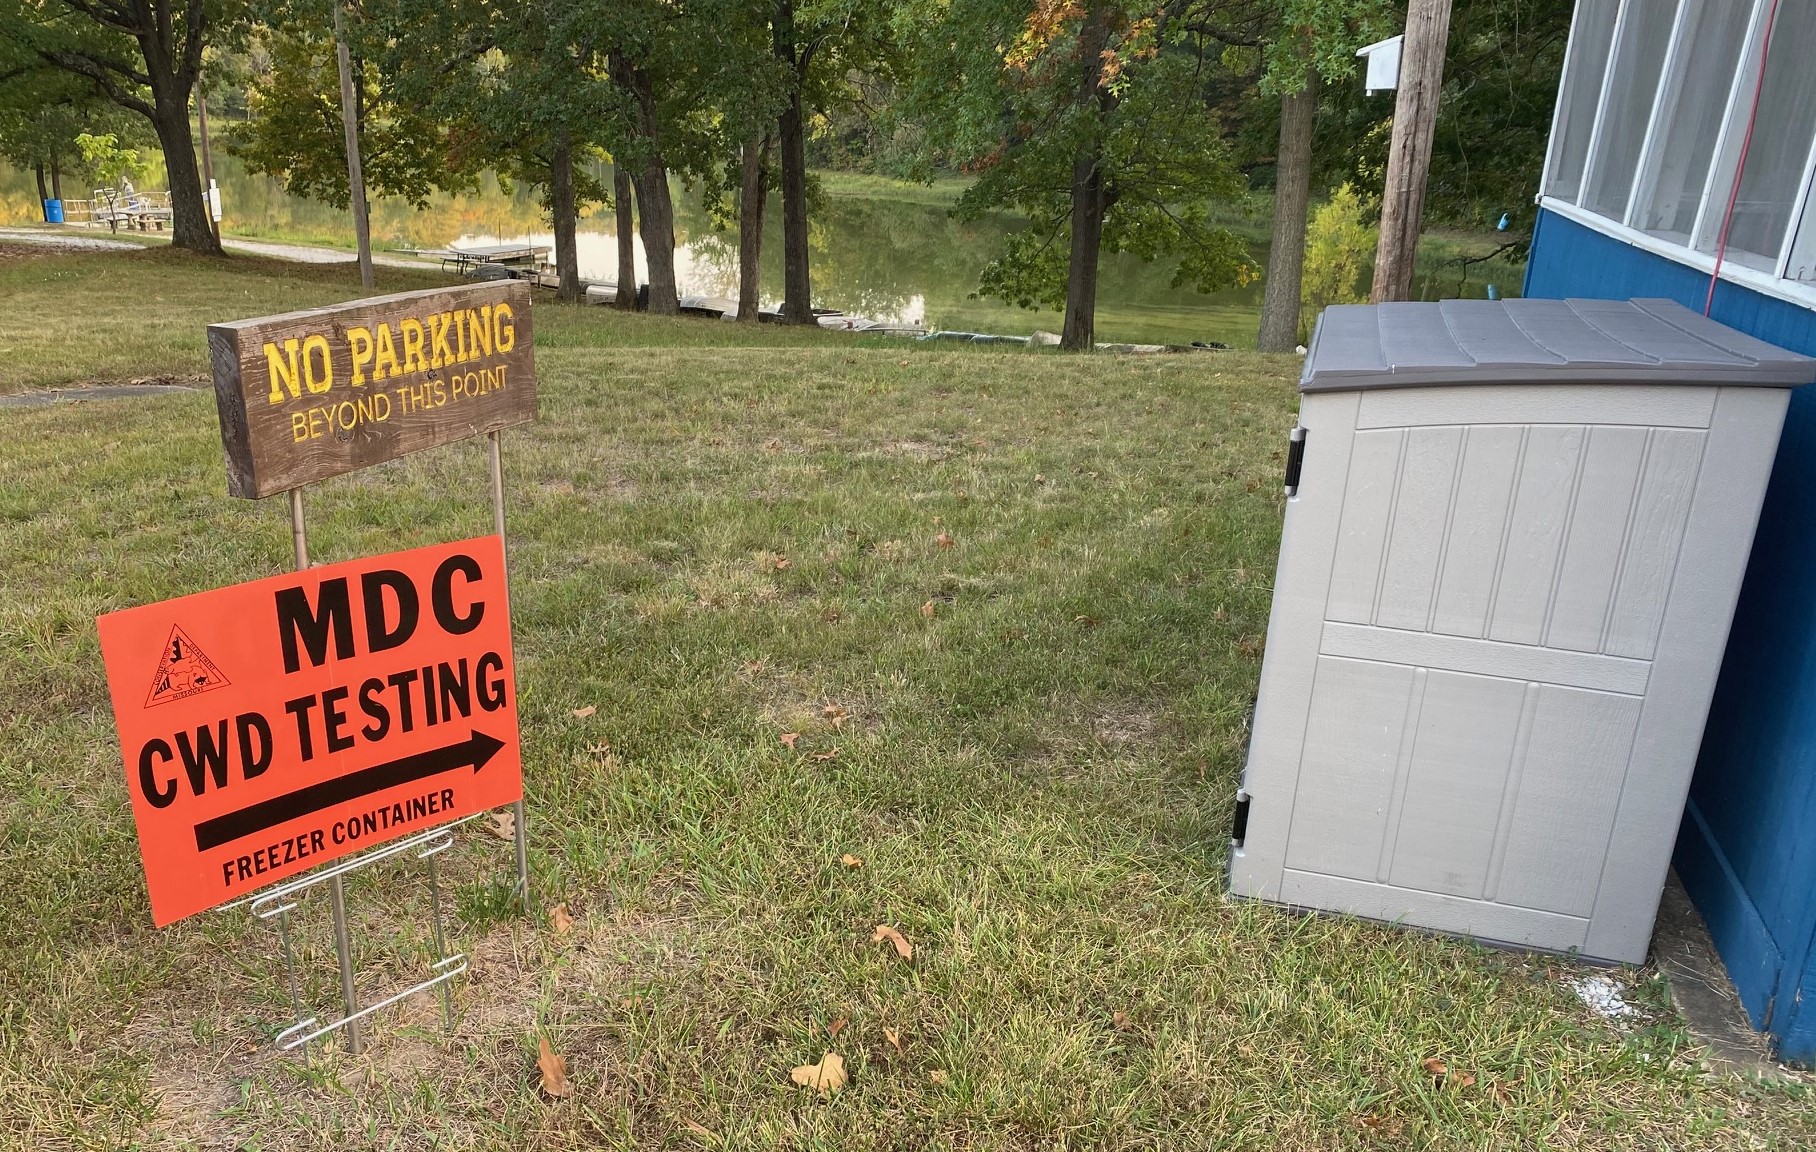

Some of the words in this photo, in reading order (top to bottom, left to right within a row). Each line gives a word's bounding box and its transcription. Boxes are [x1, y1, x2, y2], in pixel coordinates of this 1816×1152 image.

[263, 335, 333, 404] NO
[347, 303, 515, 387] PARKING
[292, 393, 391, 443] BEYOND
[396, 380, 447, 415] THIS
[452, 365, 508, 400] POINT
[274, 554, 486, 674] MDC
[138, 711, 273, 809] CWD
[285, 651, 507, 762] TESTING
[222, 831, 325, 888] FREEZER
[331, 788, 455, 846] CONTAINER
